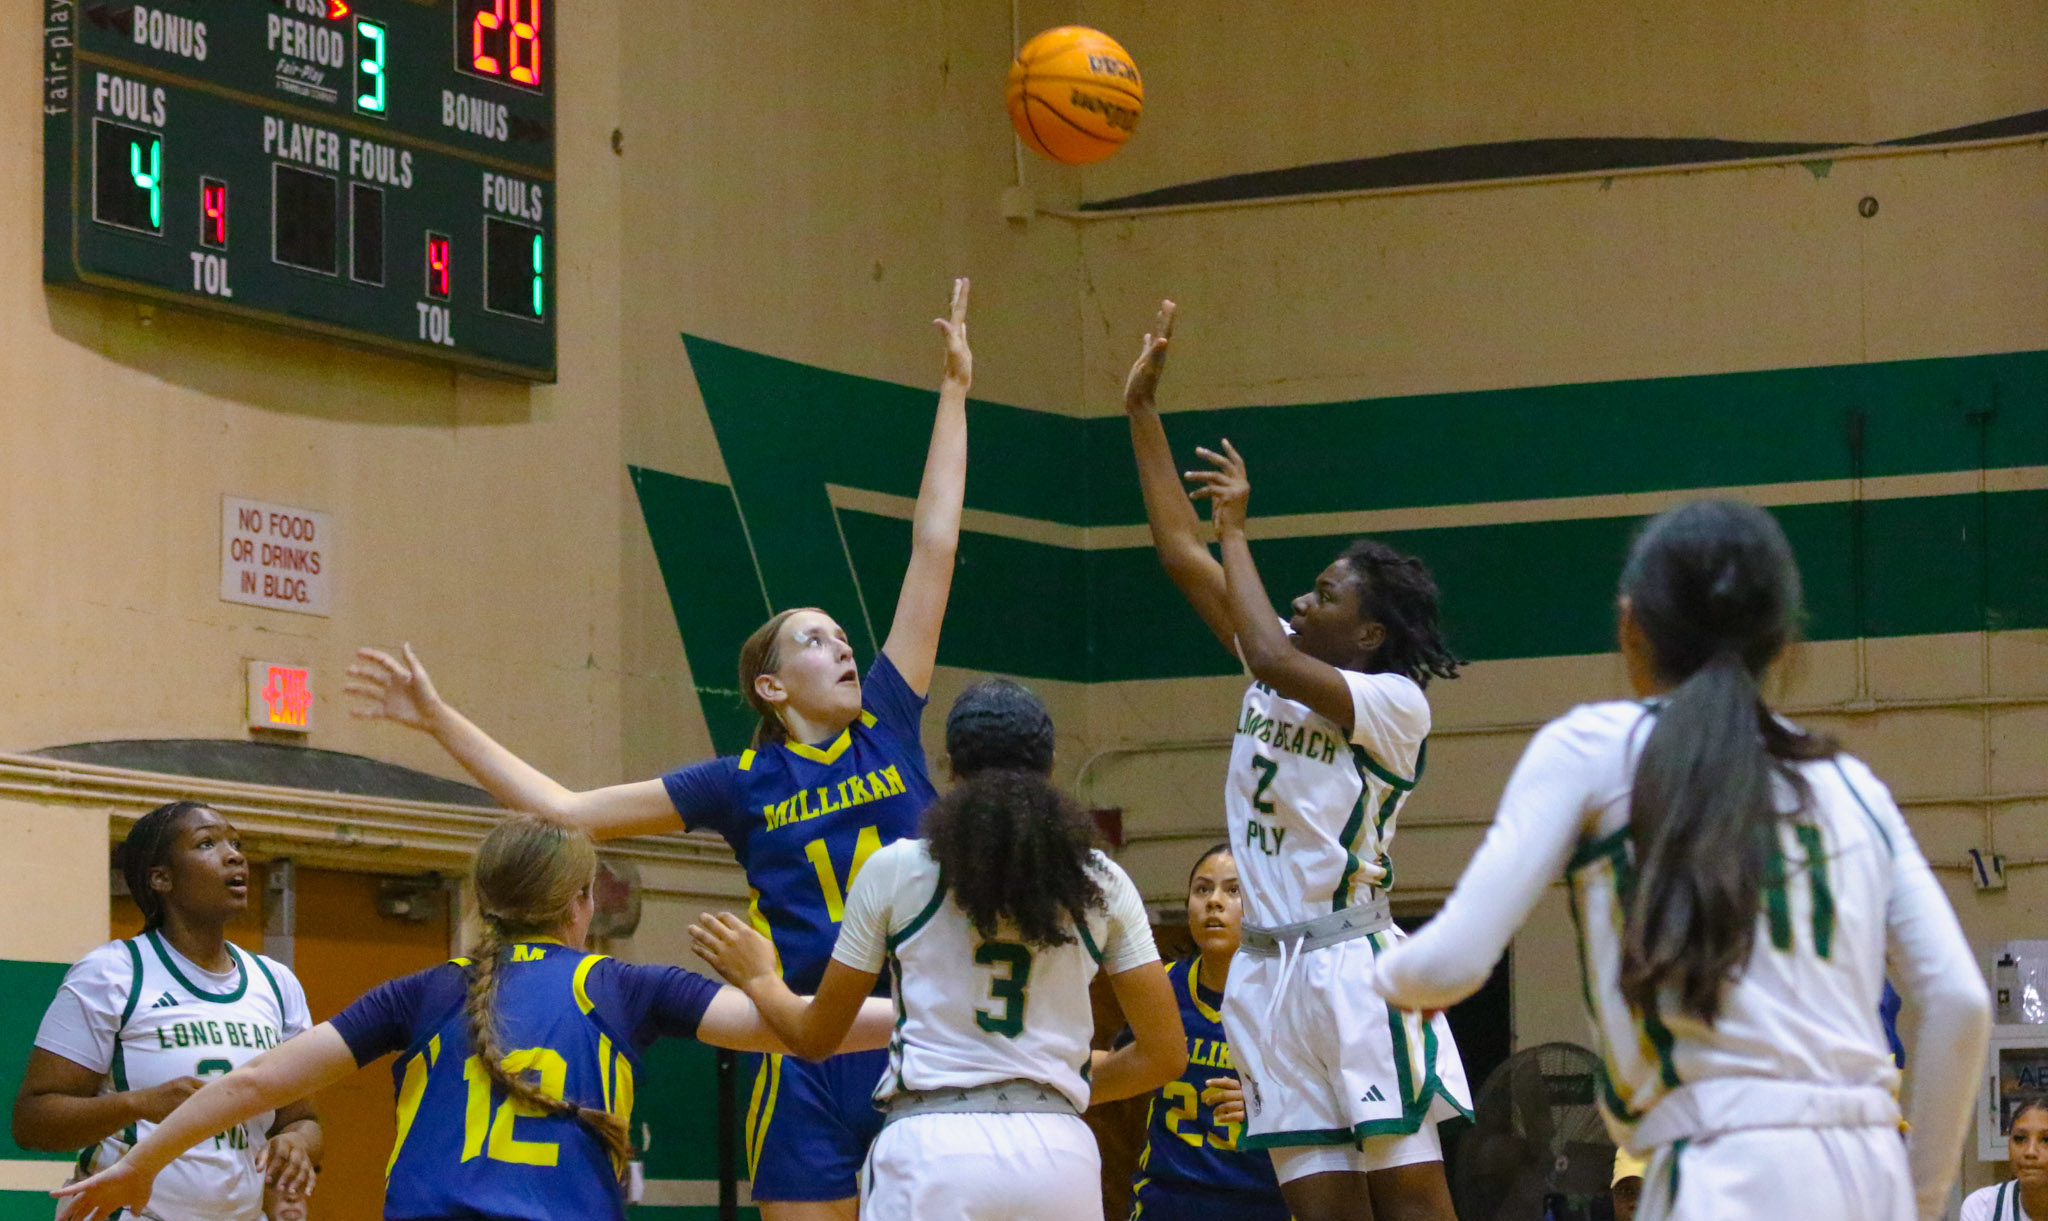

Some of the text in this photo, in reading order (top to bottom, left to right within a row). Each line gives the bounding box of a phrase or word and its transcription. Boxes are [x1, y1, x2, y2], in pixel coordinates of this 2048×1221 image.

[133, 5, 208, 61] BONUS
[267, 13, 344, 69] PERIOD
[358, 21, 385, 112] 3
[96, 72, 167, 128] FOULS
[442, 89, 509, 142] BONUS
[263, 115, 413, 189] PLAYER FOULS
[130, 139, 161, 229] 4
[482, 172, 543, 222] FOULS
[203, 185, 225, 243] 4
[190, 251, 233, 298] TOL
[428, 239, 450, 295] 4
[532, 233, 544, 316] 1
[416, 301, 455, 347] TOL
[238, 507, 316, 542] NO FOOD
[230, 537, 322, 576] OR DRINKS
[241, 570, 311, 604] IN BLDG.
[763, 763, 907, 833] MILLIKAN
[1252, 753, 1279, 815] 2
[974, 939, 1033, 1040] 3
[156, 1020, 223, 1050] LONG
[460, 1046, 568, 1168] 12
